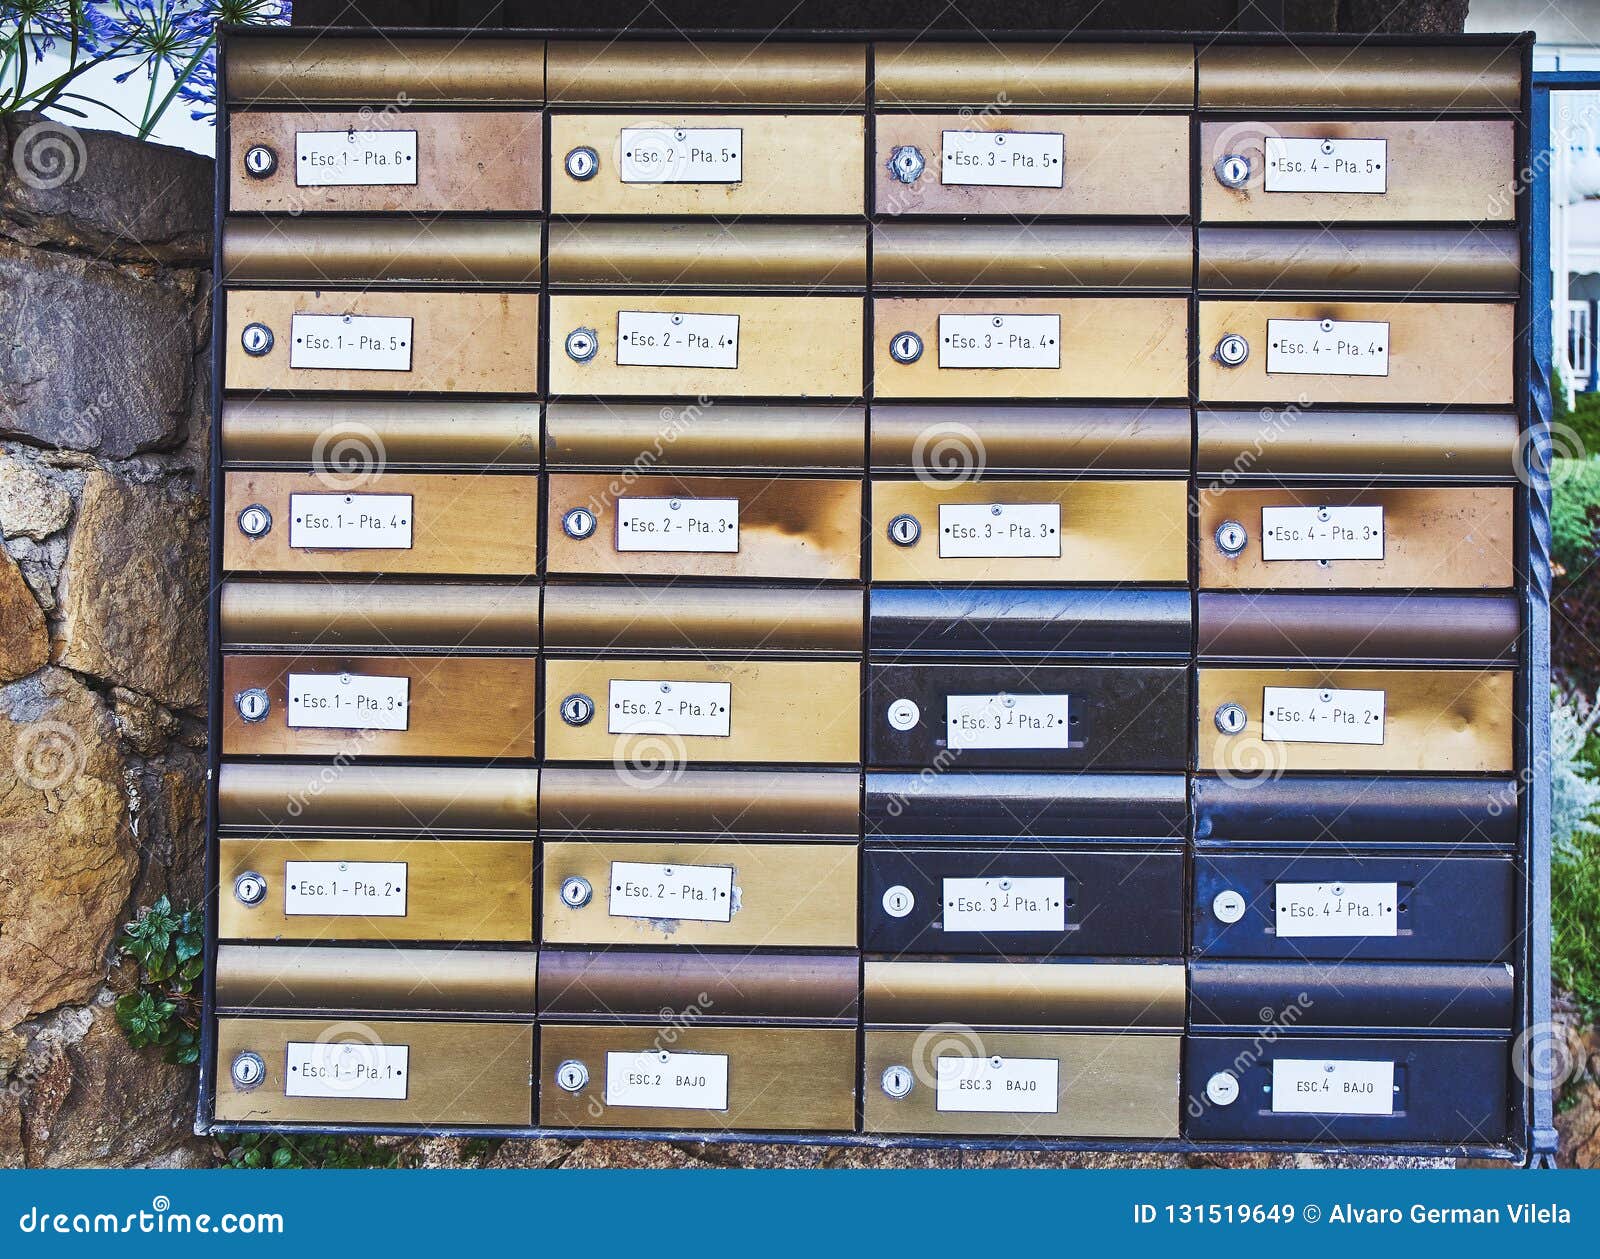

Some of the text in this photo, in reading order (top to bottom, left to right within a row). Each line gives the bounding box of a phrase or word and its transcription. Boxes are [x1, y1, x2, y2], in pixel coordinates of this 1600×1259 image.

[341, 151, 347, 166] 1
[394, 150, 402, 166] 6
[666, 148, 674, 163] 2
[721, 147, 729, 163] 5
[987, 151, 995, 167] 3
[1042, 152, 1050, 168] 5
[1310, 158, 1318, 173] 4
[1365, 158, 1373, 174] 5
[337, 335, 342, 350] 1
[389, 336, 397, 351] 5
[663, 331, 671, 347] 2
[717, 334, 726, 349] 4
[984, 333, 992, 349] 3
[1039, 334, 1047, 349] 4
[1312, 339, 1320, 355] 4
[1367, 341, 1375, 356] 4
[336, 514, 342, 529] 1
[389, 514, 397, 529] 4
[663, 517, 671, 533] 2
[718, 518, 726, 534] 3
[984, 523, 992, 541] 3
[1039, 523, 1048, 538] 3
[1307, 526, 1315, 541] 4
[1362, 525, 1370, 541] 3
[334, 693, 340, 709] 1
[386, 695, 394, 711] 3
[654, 700, 662, 716] 2
[709, 701, 718, 717] 2
[994, 715, 1002, 730] 3
[1308, 707, 1316, 723] 4
[1363, 709, 1372, 725] 2
[331, 880, 337, 896] 1
[384, 880, 392, 897] 2
[657, 883, 665, 899] 2
[712, 886, 717, 902] 1
[989, 897, 998, 912] 3
[1044, 896, 1050, 912] 1
[1322, 902, 1331, 917] 4
[1377, 901, 1383, 917] 1
[334, 1063, 339, 1078] 1
[386, 1064, 392, 1080] 1
[675, 1075, 706, 1088] BAJO
[1006, 1079, 1037, 1093] BAJO
[1343, 1081, 1374, 1094] BAJO
